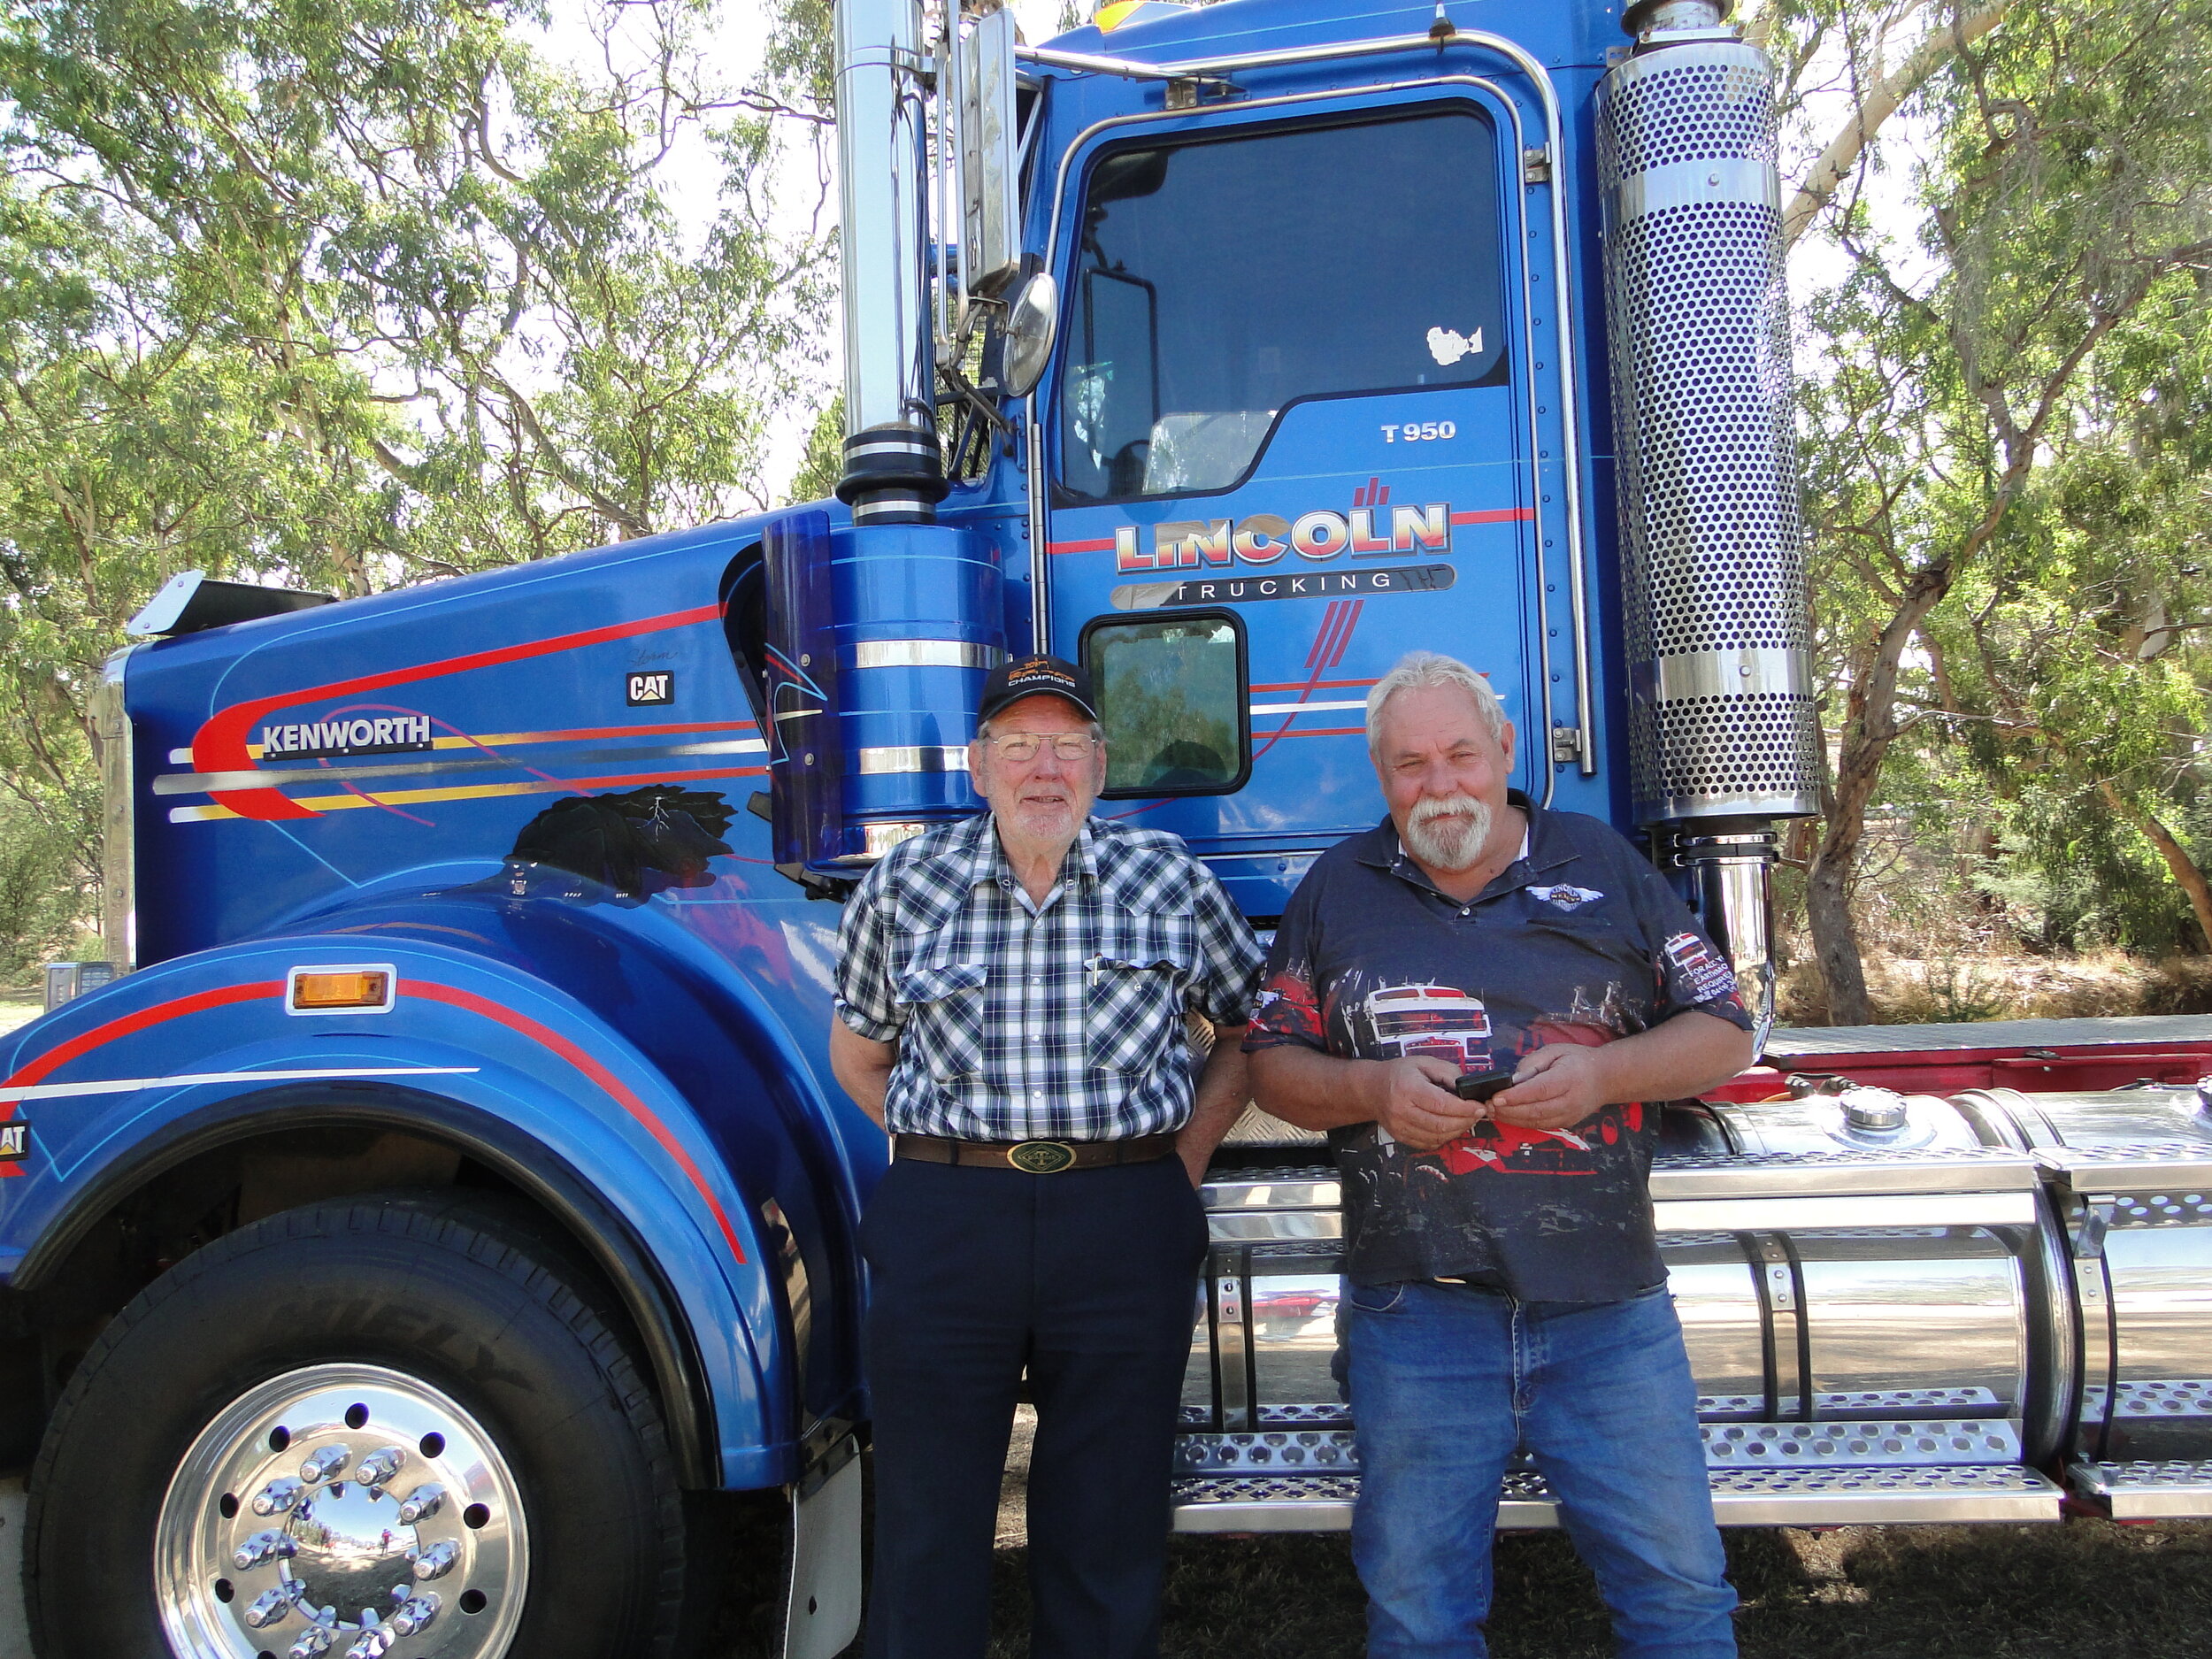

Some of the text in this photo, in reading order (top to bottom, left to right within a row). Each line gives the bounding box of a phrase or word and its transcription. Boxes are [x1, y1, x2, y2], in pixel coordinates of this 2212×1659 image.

[1116, 502, 1451, 576] LINCOLN
[1178, 572, 1390, 601] TRUCKING
[630, 674, 669, 701] CAT
[1008, 674, 1076, 687] CHAMPIONS
[263, 715, 431, 753] KENWORTH
[1689, 964, 1706, 977] FOR
[0, 1125, 26, 1154] AT
